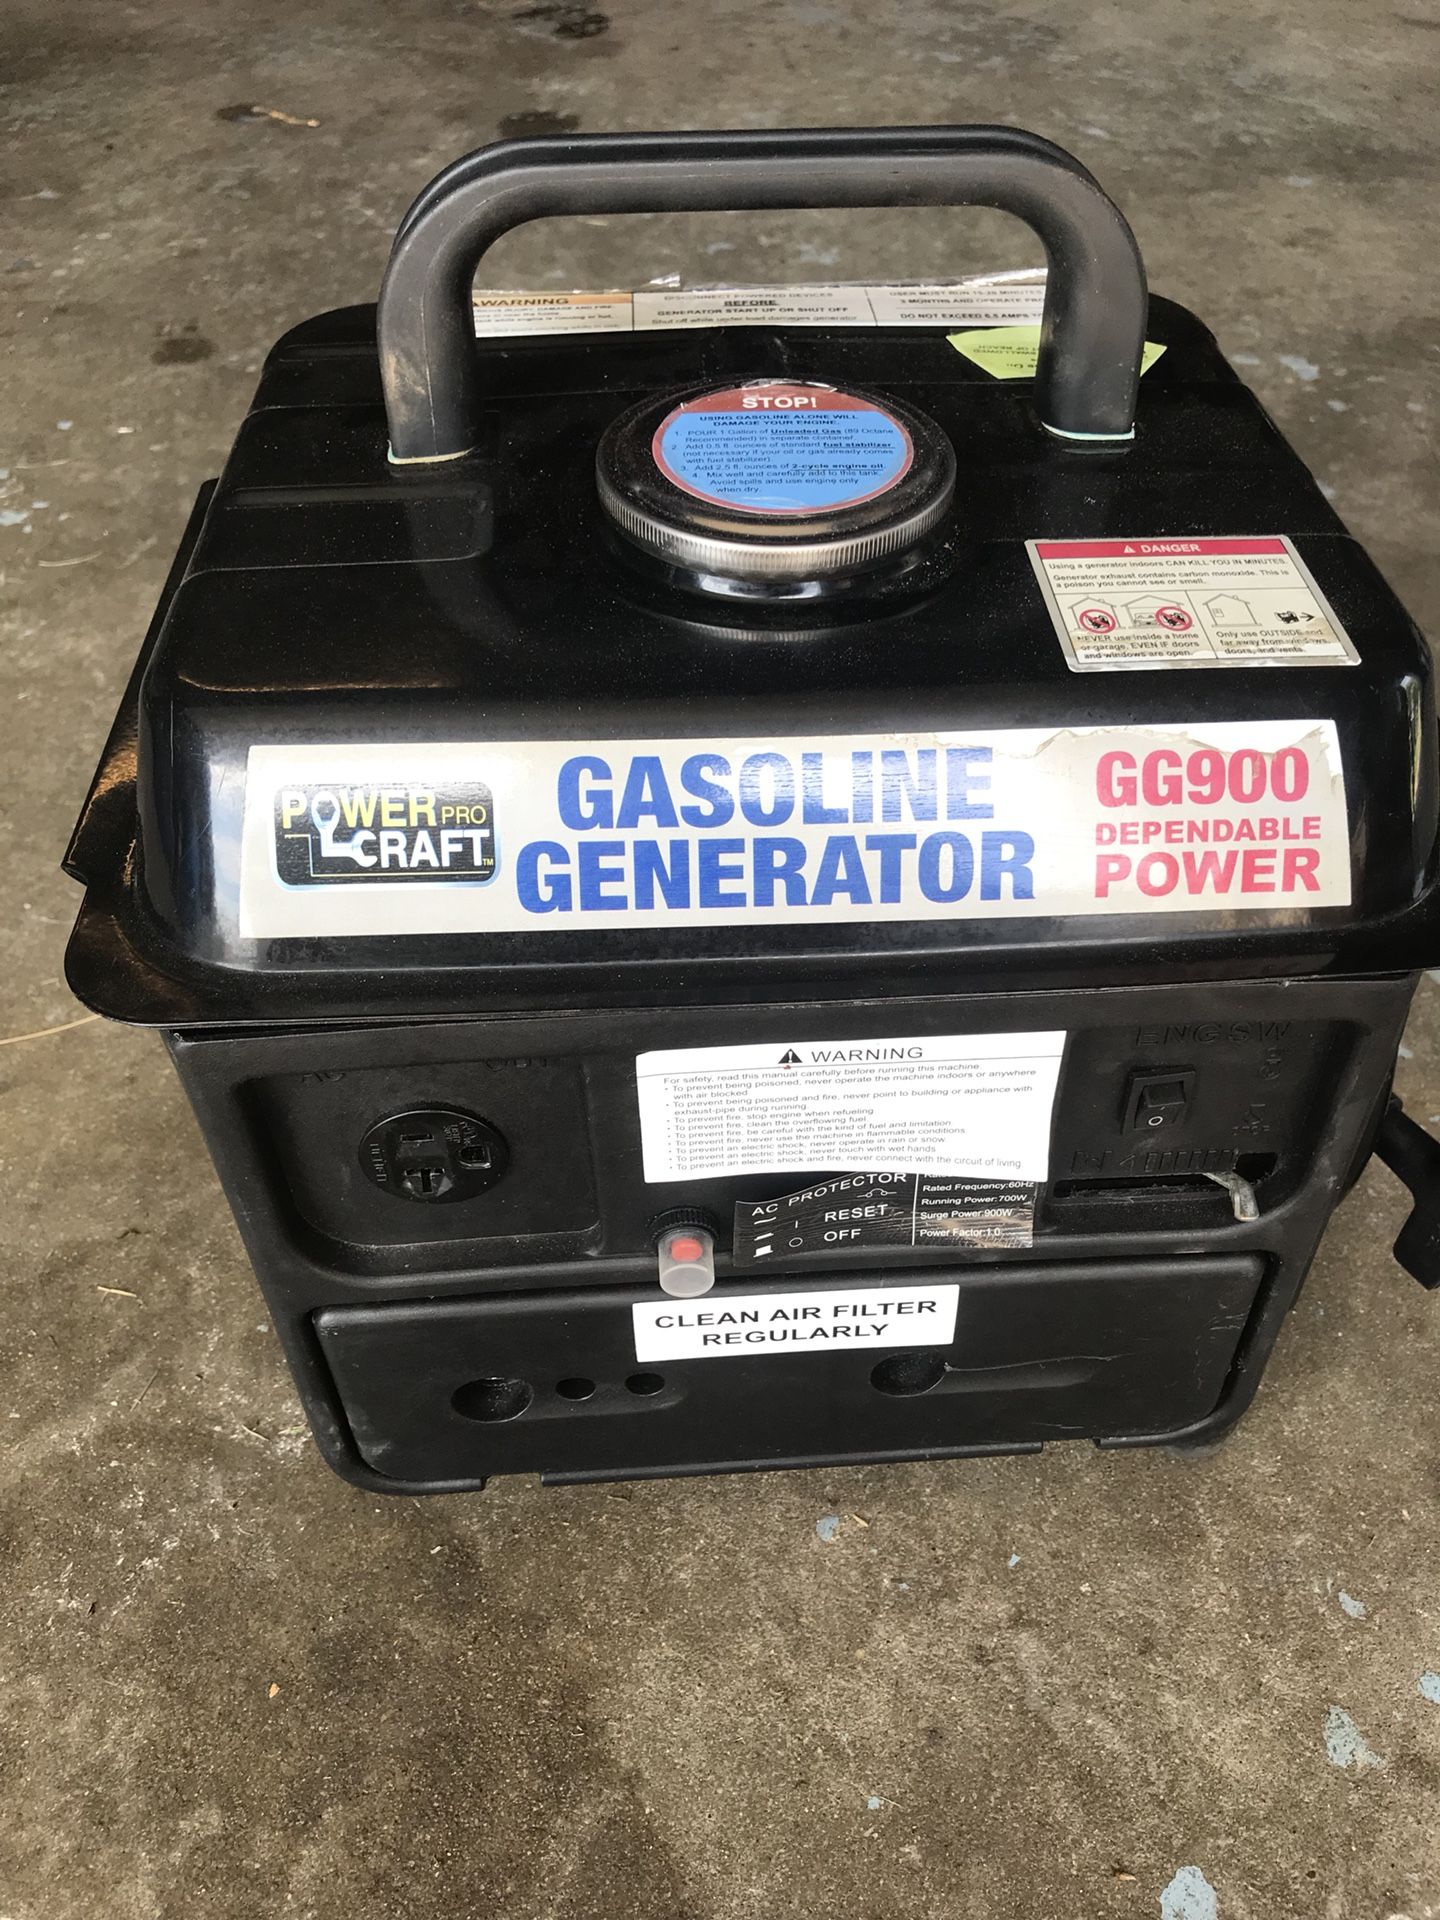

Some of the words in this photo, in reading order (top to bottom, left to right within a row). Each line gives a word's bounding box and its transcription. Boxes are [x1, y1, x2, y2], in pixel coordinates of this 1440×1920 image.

[480, 298, 568, 306] WARNING
[742, 396, 817, 409] STOP!
[1140, 544, 1201, 554] DANGER
[1084, 562, 1127, 570] generator
[1129, 560, 1164, 568] indoors
[1165, 559, 1186, 567] CAN
[1064, 581, 1095, 589] poison
[1097, 580, 1114, 588] you
[1216, 630, 1238, 639] Only
[1259, 629, 1301, 637] OUTSIDE
[1130, 642, 1158, 650] EVEN
[1172, 640, 1200, 648] doors
[1103, 650, 1146, 658] windows
[1096, 747, 1309, 808] GG900
[558, 747, 995, 832] GASOLINE
[282, 789, 439, 830] POWER
[441, 805, 487, 825] PRO
[1095, 816, 1321, 846] DEPENDABLE
[352, 828, 490, 869] CRAFT
[516, 830, 1036, 914] GENERATOR
[1094, 847, 1321, 899] POWER
[811, 1046, 923, 1063] WARNING
[717, 1073, 739, 1081] read
[742, 1072, 759, 1080] this
[761, 1071, 798, 1079] manual
[800, 1069, 842, 1077] carefully
[844, 1067, 875, 1076] before
[878, 1066, 915, 1074] running
[917, 1064, 935, 1072] this
[686, 1083, 723, 1092] prevent
[725, 1081, 752, 1089] being
[834, 1076, 872, 1085] operate
[875, 1074, 890, 1082] the
[893, 1073, 934, 1081] machine
[937, 1071, 973, 1079] indoors
[988, 1069, 1037, 1078] anywhere
[710, 1090, 749, 1098] blocked
[674, 1106, 736, 1116] exhaust-pipe
[738, 1105, 768, 1113] during
[771, 1103, 807, 1111] running
[875, 1154, 913, 1163] connect
[915, 1155, 934, 1163] with
[936, 1155, 952, 1164] the
[954, 1157, 982, 1166] circuit
[984, 1158, 995, 1167] of
[922, 1184, 952, 1192] Rated
[954, 1180, 1034, 1191] Frequency:60Hz
[751, 1203, 778, 1216] AC
[788, 1172, 907, 1207] PROTECTOR
[921, 1197, 962, 1206] Running
[824, 1204, 889, 1222] RESET
[920, 1210, 949, 1221] Surge
[823, 1228, 862, 1242] OFF
[919, 1227, 950, 1237] Power
[654, 1310, 759, 1328] CLEAN
[769, 1307, 822, 1322] AIR
[832, 1300, 938, 1318] FILTER
[702, 1323, 889, 1346] REGULARLY
